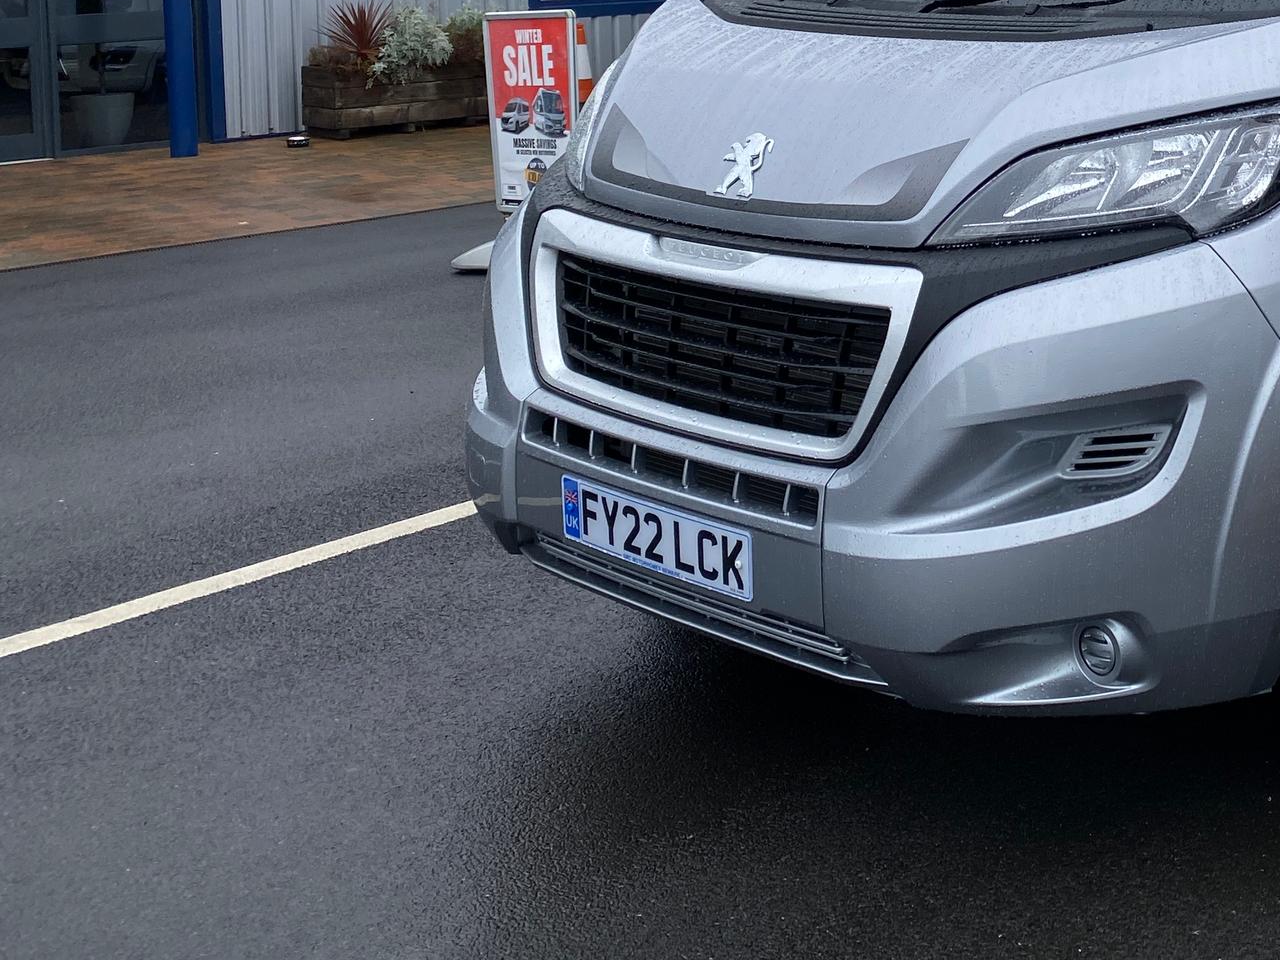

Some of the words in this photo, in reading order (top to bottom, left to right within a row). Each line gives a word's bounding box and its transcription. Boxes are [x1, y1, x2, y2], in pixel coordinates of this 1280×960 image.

[503, 45, 555, 87] SALE
[566, 514, 579, 530] UK
[581, 488, 664, 565] FY22
[673, 520, 745, 591] LCK
